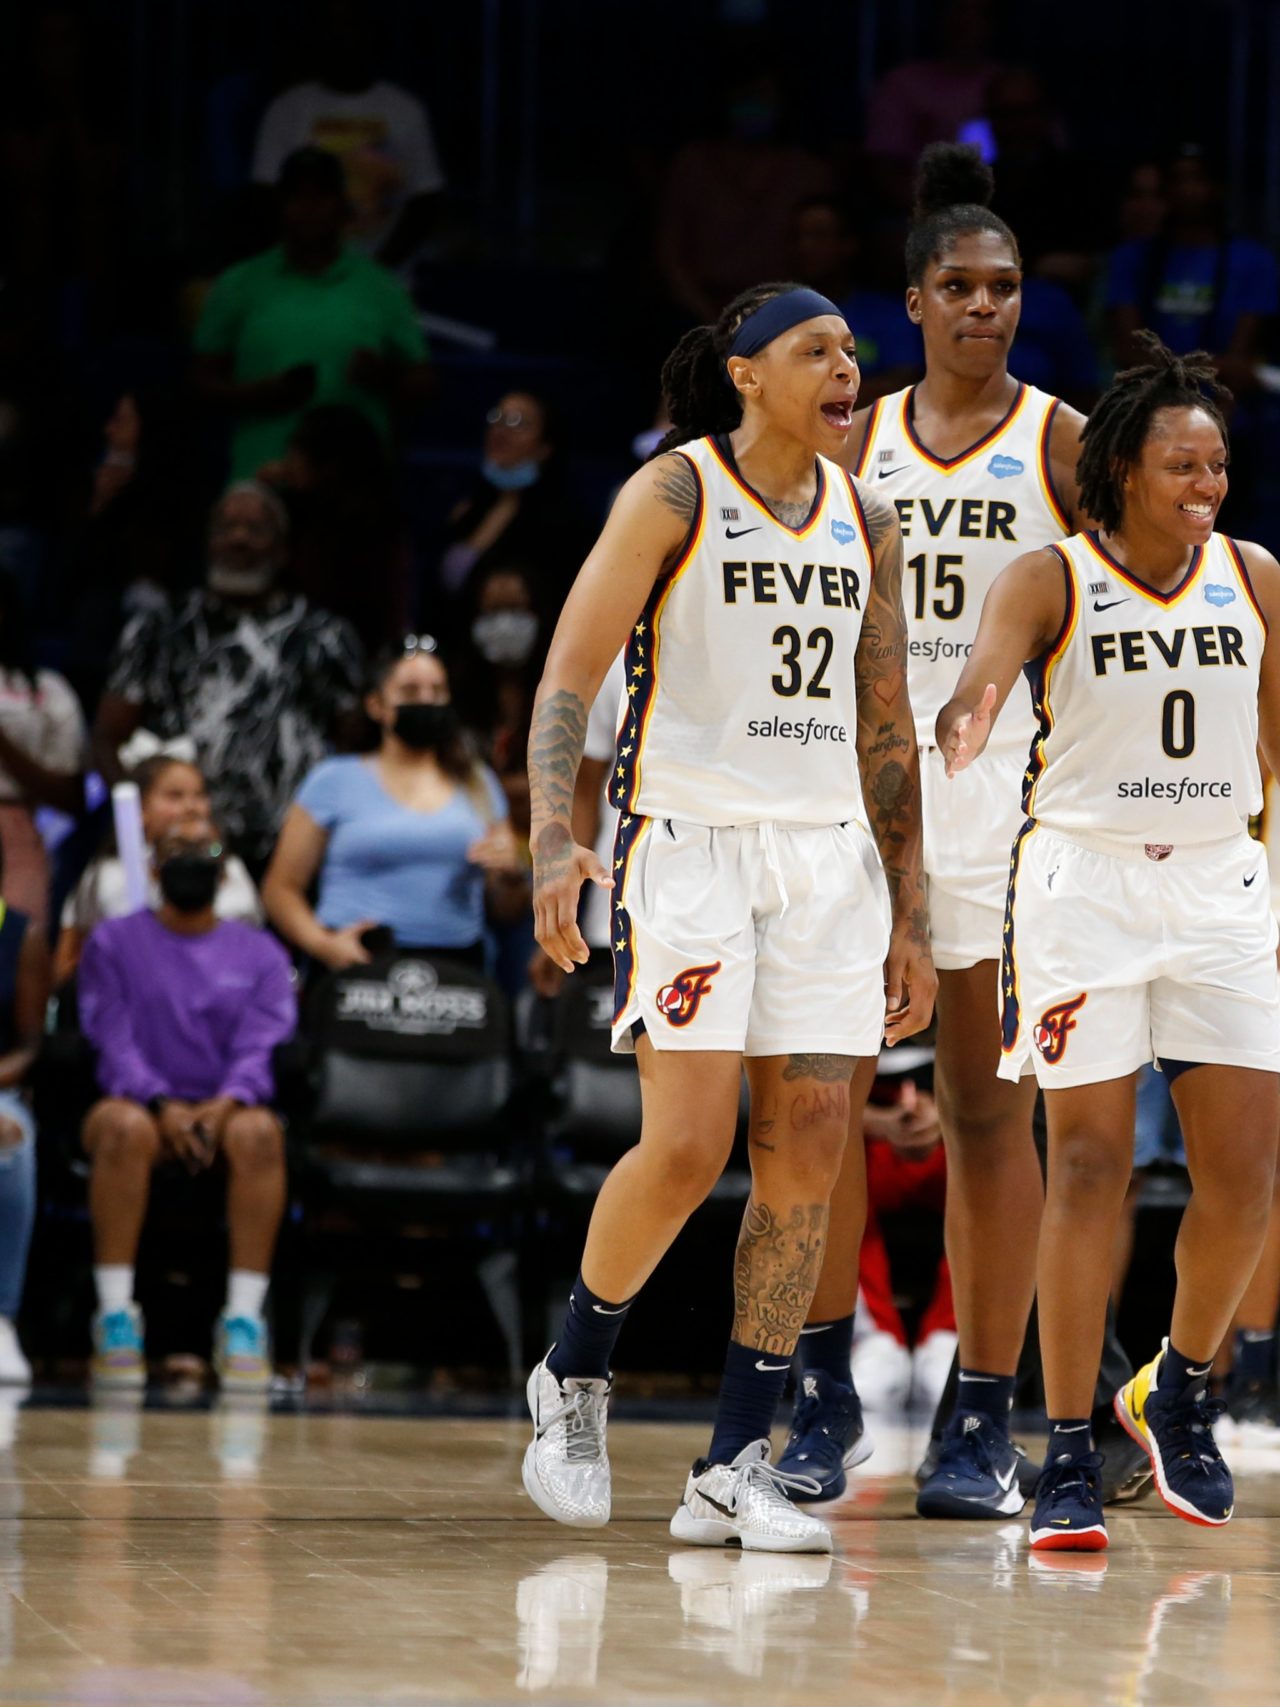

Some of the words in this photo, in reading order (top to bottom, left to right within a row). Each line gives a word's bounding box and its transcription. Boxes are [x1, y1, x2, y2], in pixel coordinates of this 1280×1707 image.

[894, 498, 1019, 542] EVER
[722, 561, 861, 611] FEVER
[907, 552, 966, 622] 15
[771, 624, 835, 700] 32
[909, 637, 973, 663] esforc
[1091, 625, 1249, 677] FEVER
[746, 715, 847, 745] salesforce
[1161, 689, 1196, 760] 0
[1117, 776, 1232, 805] salesforce
[757, 1302, 801, 1329] FORG
